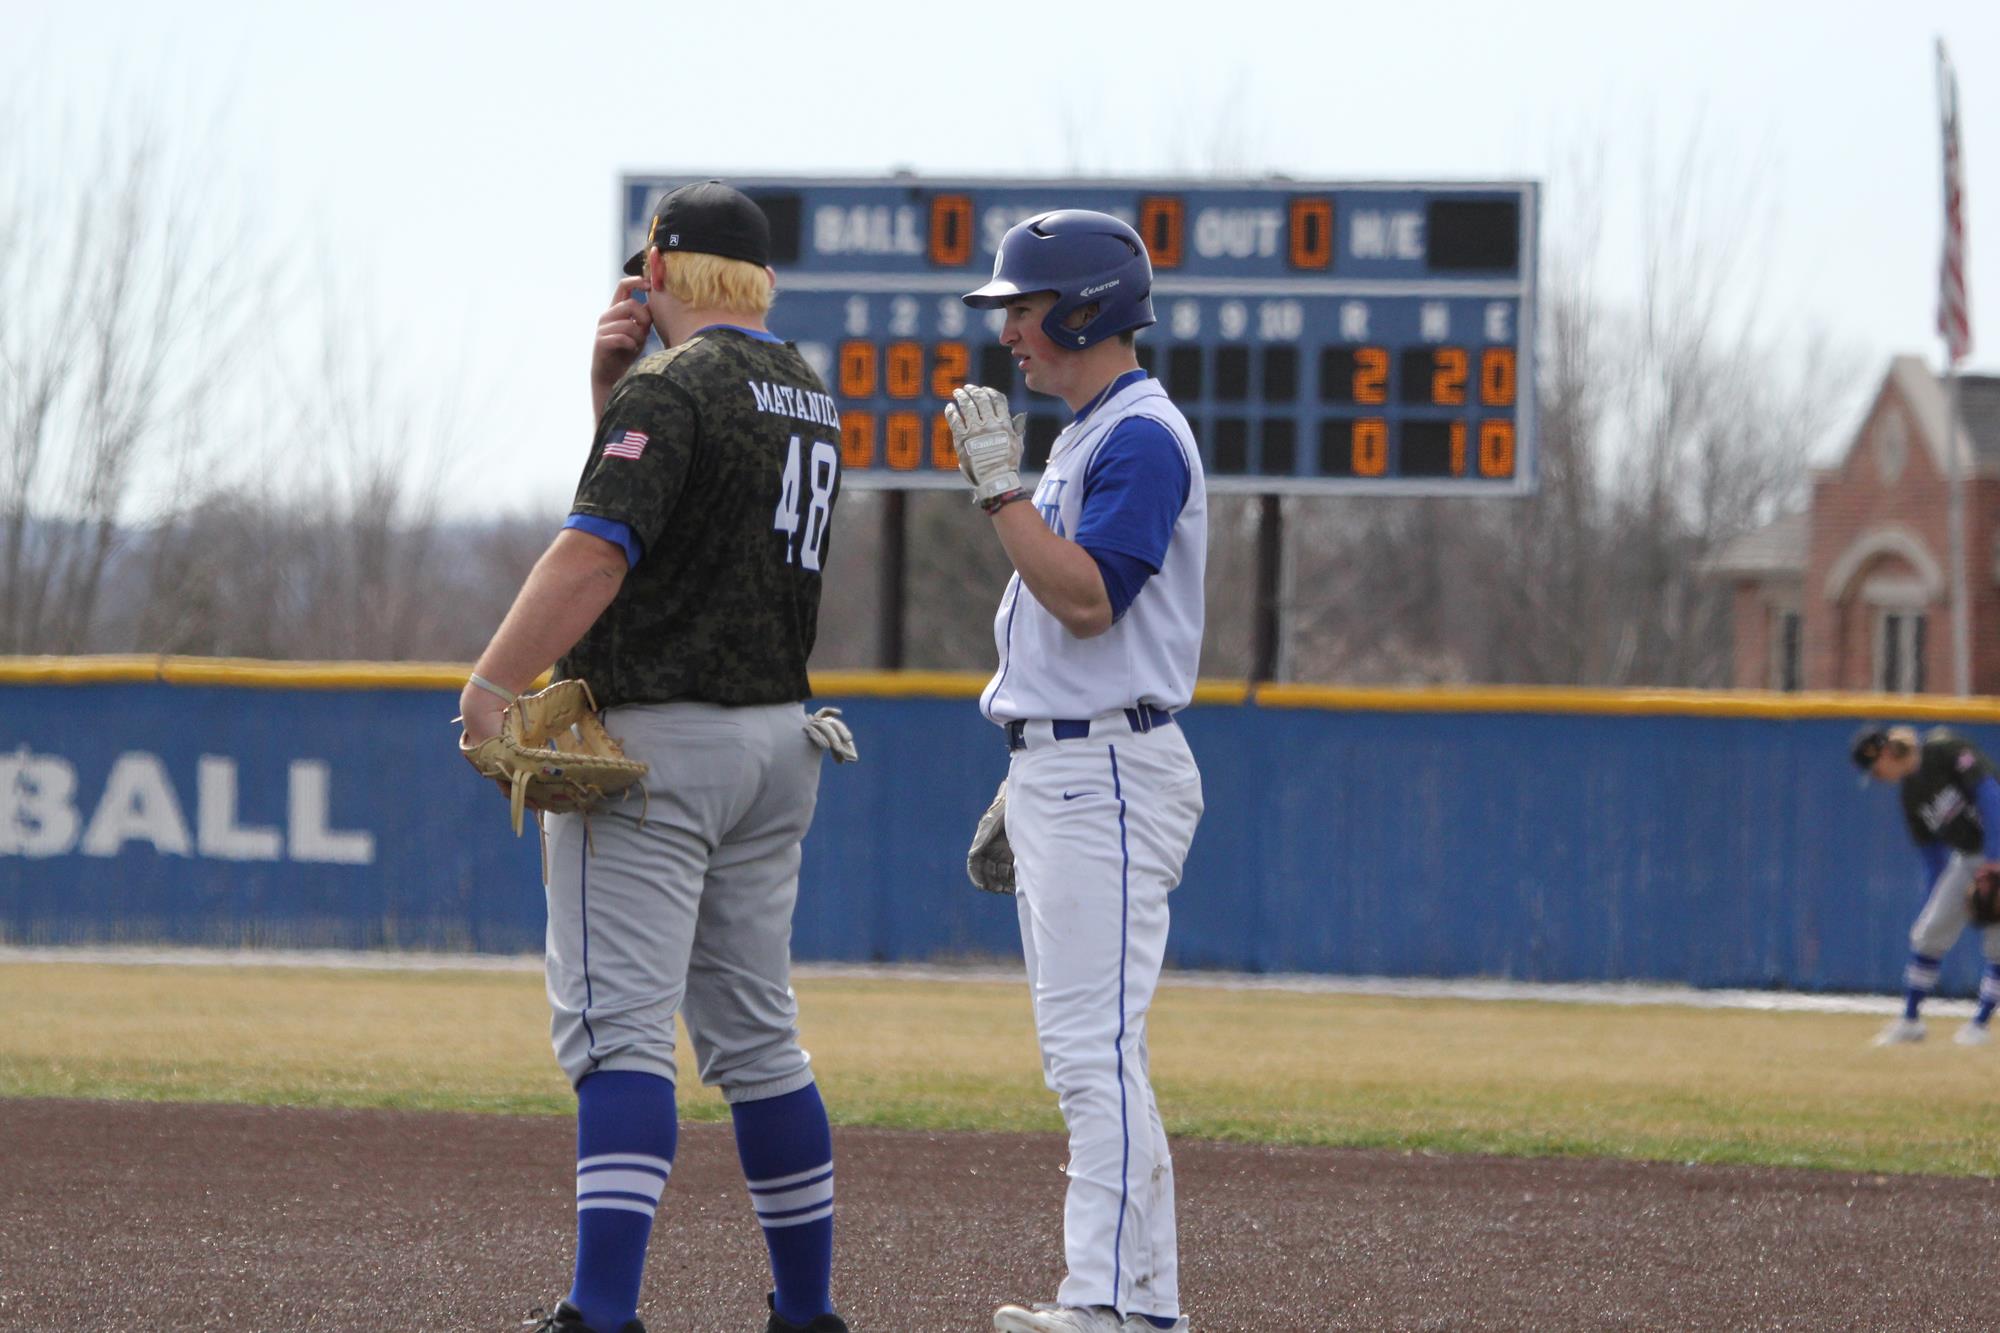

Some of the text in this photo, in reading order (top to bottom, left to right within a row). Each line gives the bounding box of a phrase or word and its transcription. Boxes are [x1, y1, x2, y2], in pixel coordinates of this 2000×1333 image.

[813, 206, 921, 255] BALL
[929, 195, 973, 266] 0
[1140, 197, 1185, 268] 0
[1193, 208, 1286, 258] OUT
[1290, 198, 1334, 269] 0
[1088, 279, 1120, 295] EASTON
[840, 340, 877, 397] 0
[886, 341, 923, 398] 0
[932, 341, 970, 398] 2
[1352, 347, 1389, 405] 2
[1431, 347, 1468, 406] 2
[1480, 347, 1516, 406] 0
[841, 410, 876, 469] 0
[886, 410, 923, 470] 0
[1351, 417, 1388, 476] 0
[1449, 419, 1466, 477] 1
[1479, 419, 1514, 478] 0
[774, 436, 837, 571] 48
